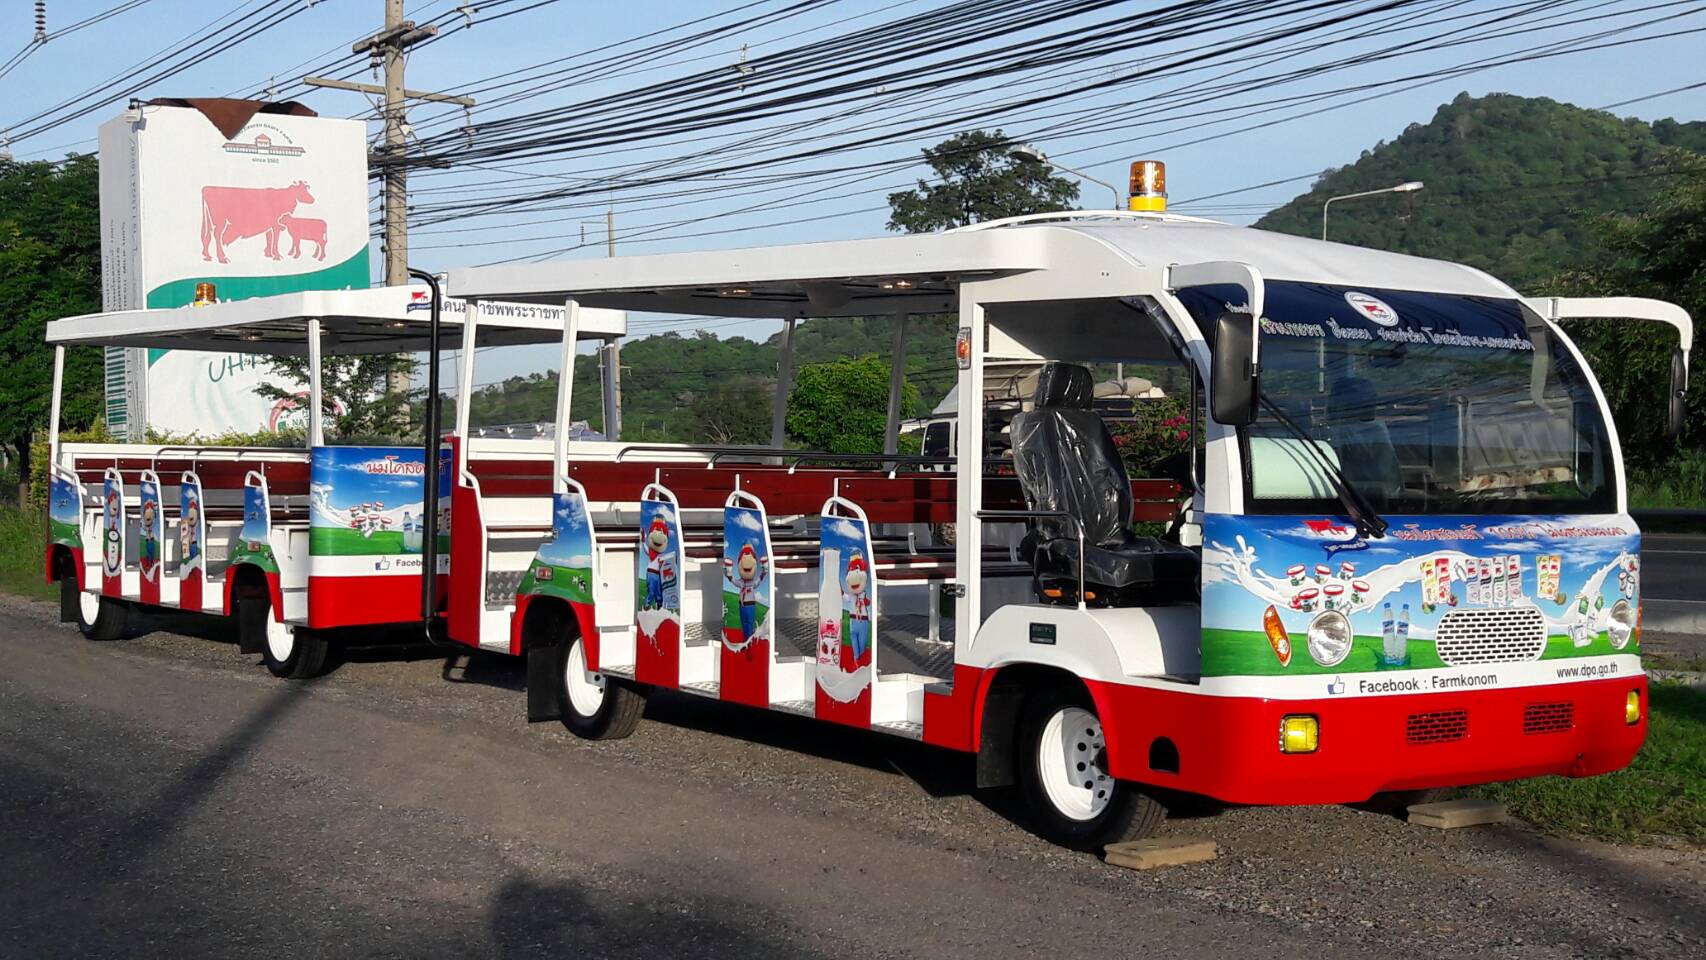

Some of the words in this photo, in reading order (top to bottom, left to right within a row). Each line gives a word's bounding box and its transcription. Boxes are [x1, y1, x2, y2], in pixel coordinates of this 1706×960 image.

[396, 558, 423, 568] Faceb
[1556, 661, 1618, 678] www.dpo.go.th
[1359, 678, 1420, 693] Facebook
[1432, 673, 1498, 688] Farmkonom
